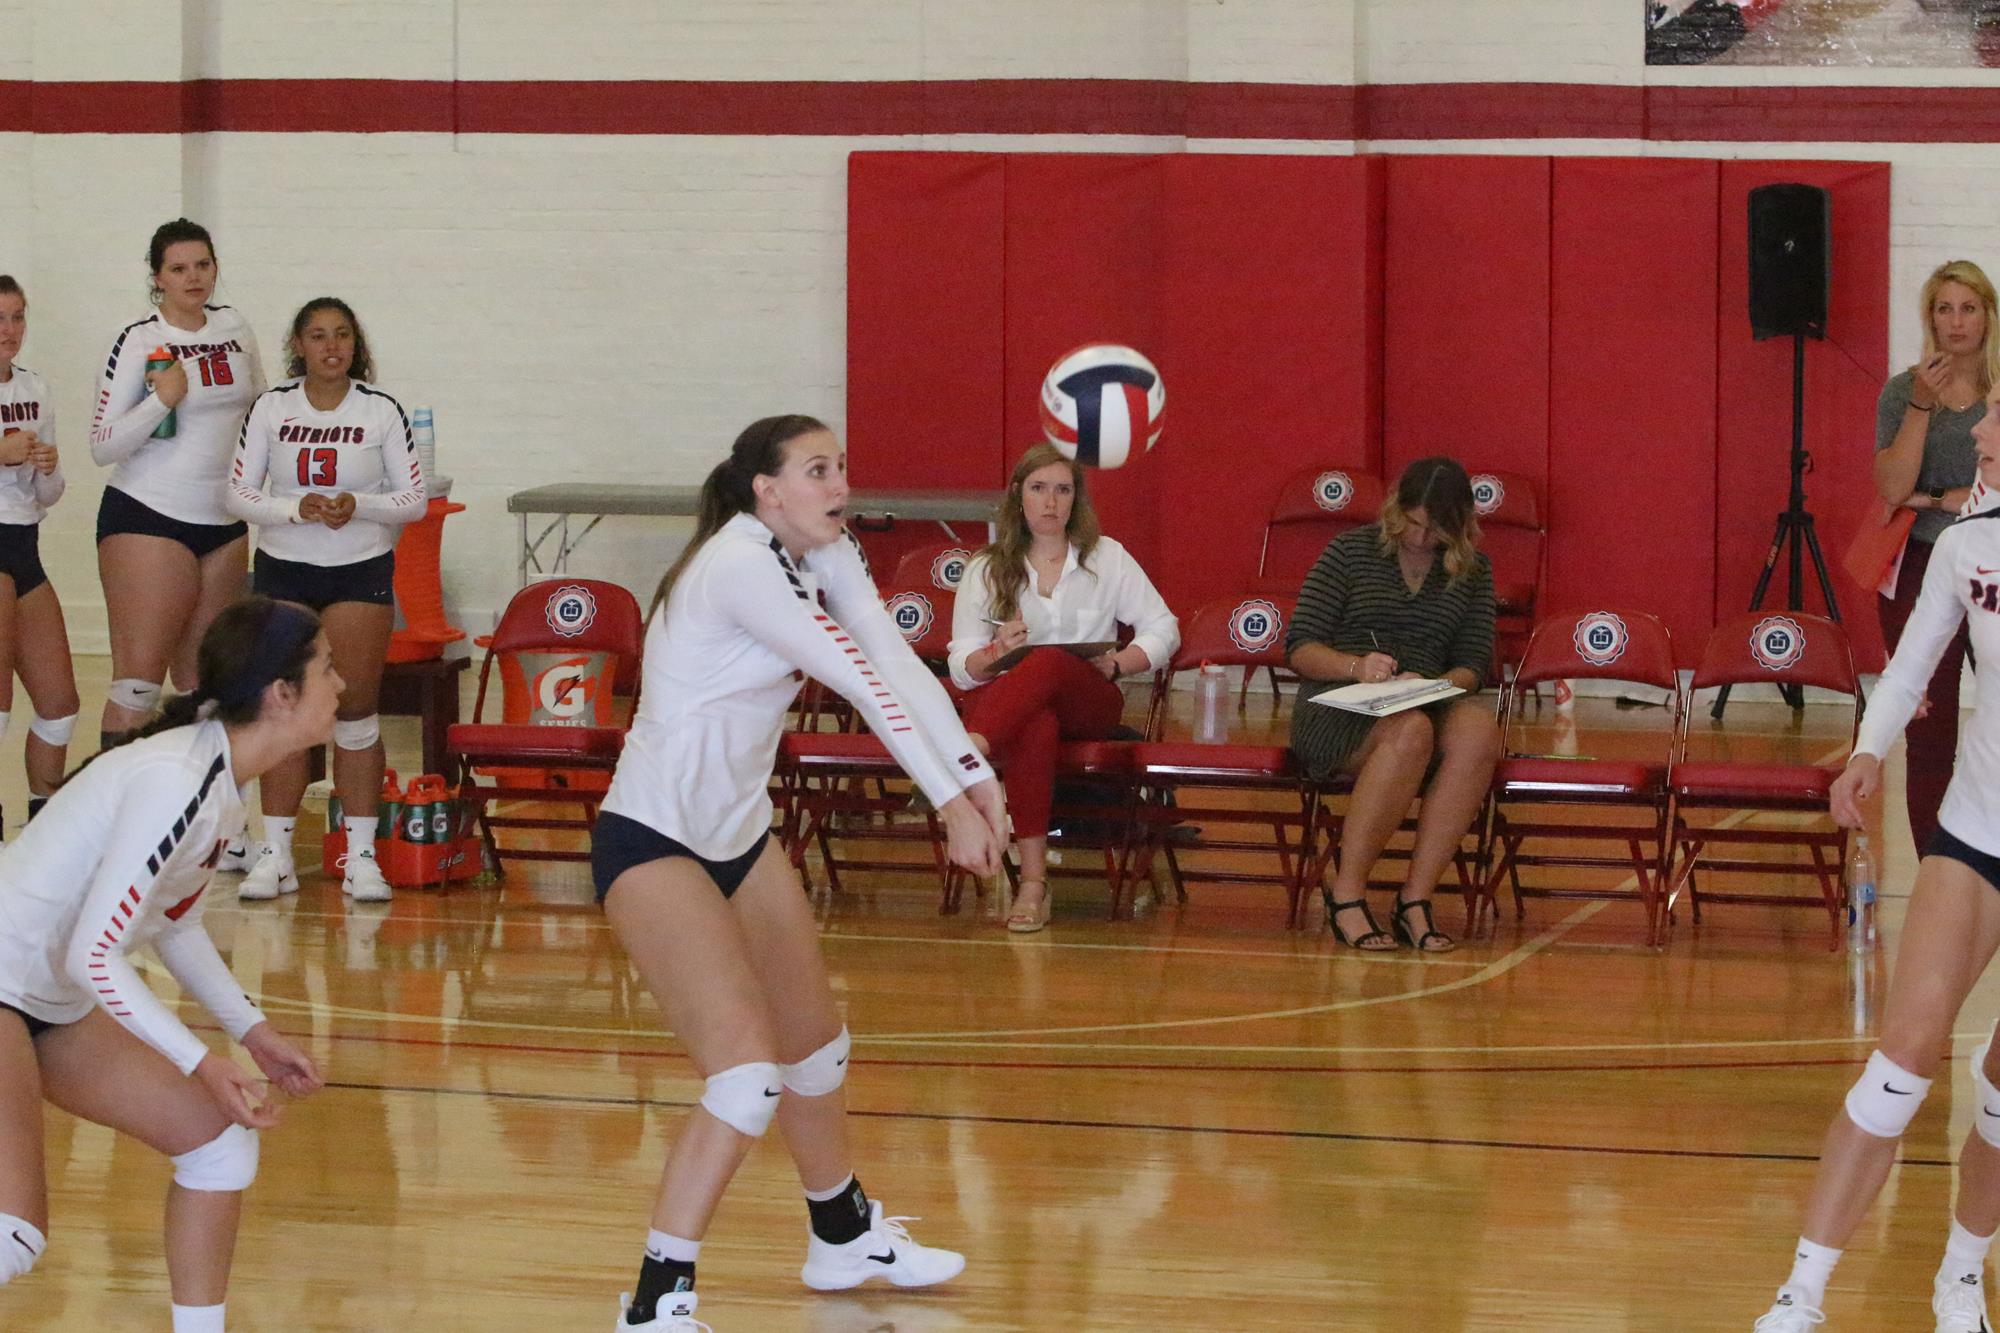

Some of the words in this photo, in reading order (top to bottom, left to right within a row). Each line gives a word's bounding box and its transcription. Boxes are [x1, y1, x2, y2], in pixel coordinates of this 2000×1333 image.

[279, 425, 364, 444] PATRIOTS
[297, 447, 338, 487] 13
[1969, 578, 2000, 614] PA
[540, 664, 585, 717] G
[407, 818, 425, 838] G
[432, 813, 448, 833] G
